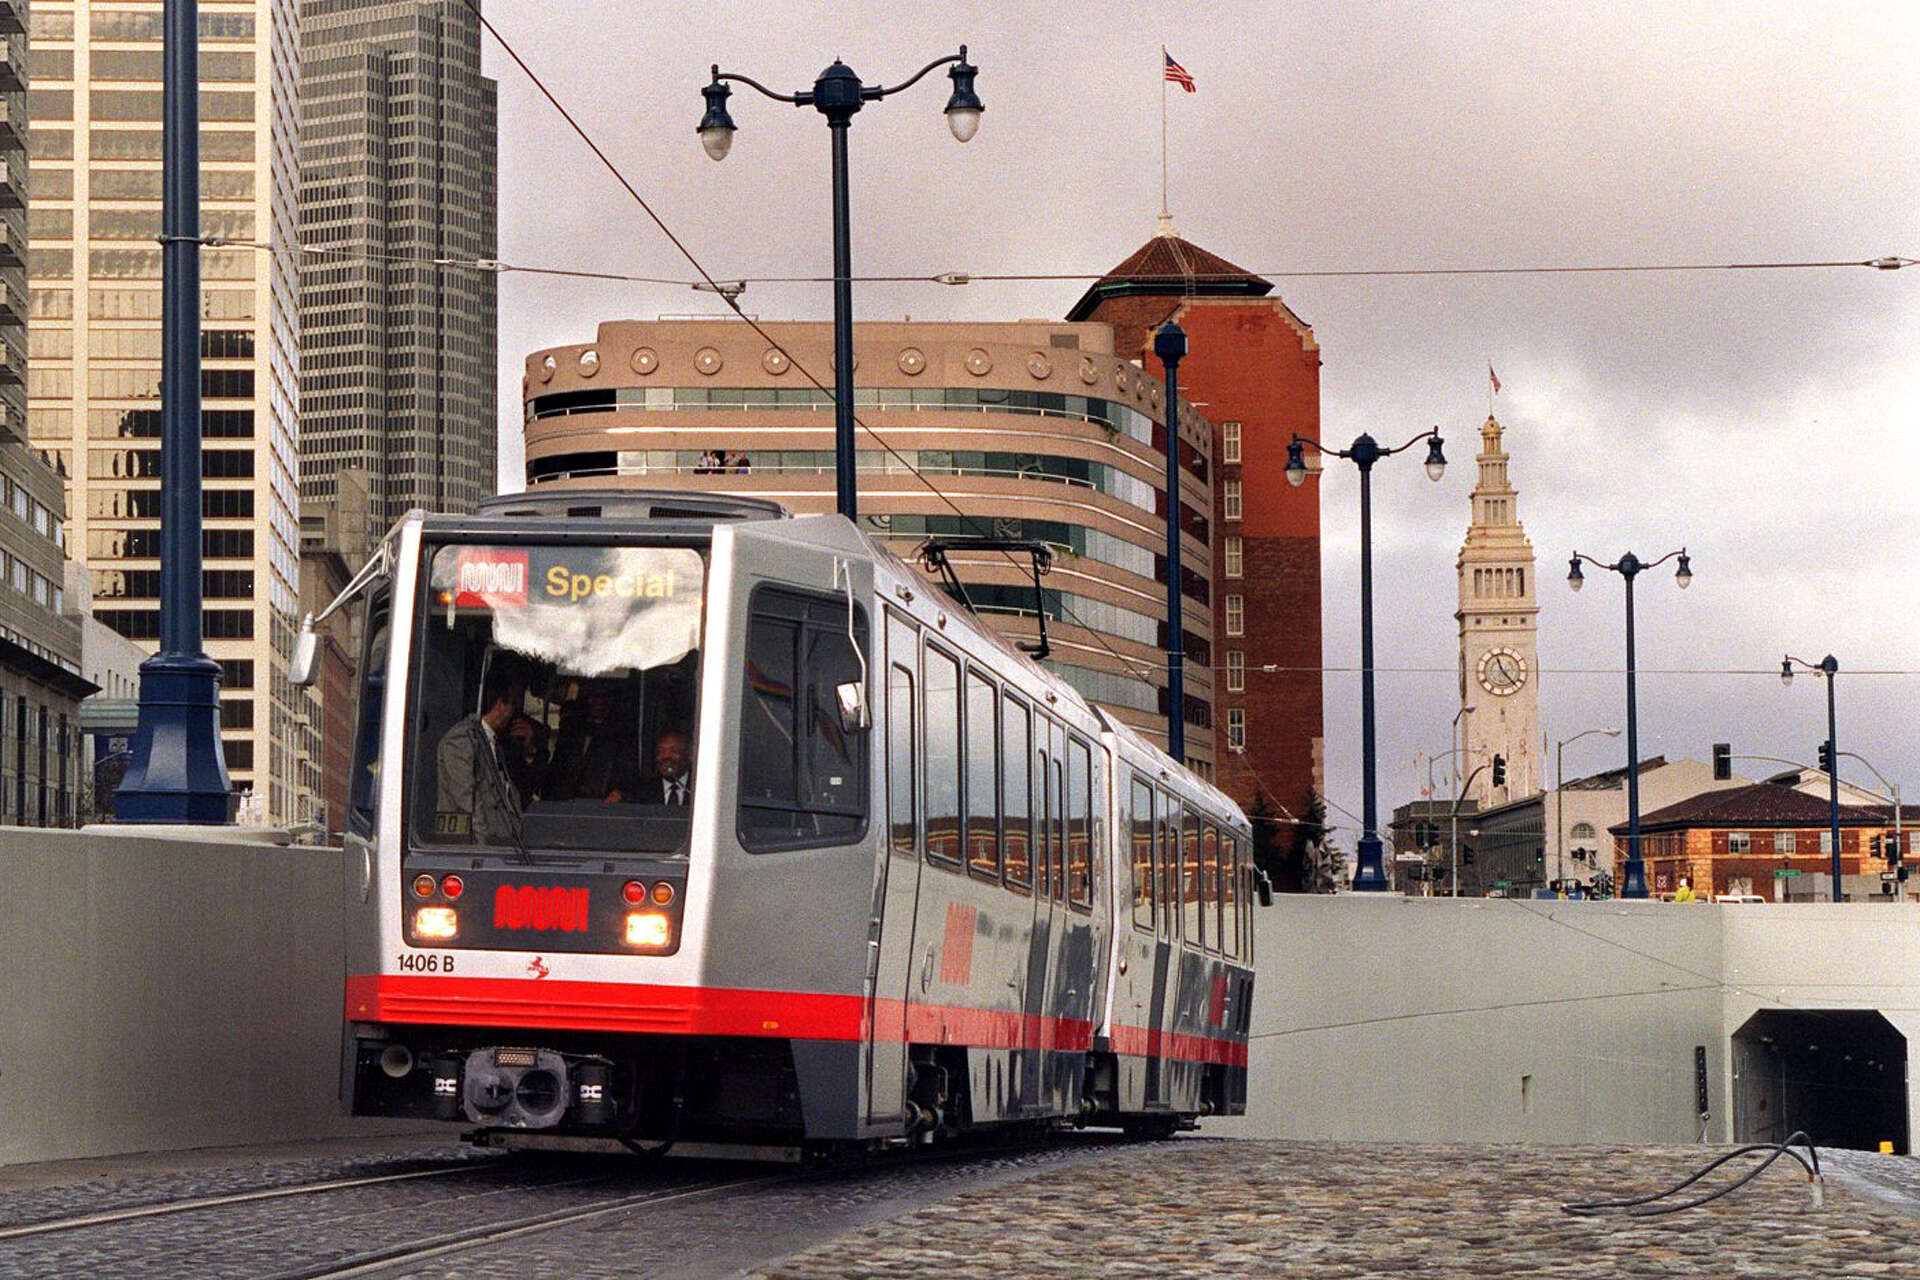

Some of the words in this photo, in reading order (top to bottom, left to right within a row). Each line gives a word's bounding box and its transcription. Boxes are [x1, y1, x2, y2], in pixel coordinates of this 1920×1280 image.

[546, 565, 675, 602] Special
[397, 954, 438, 972] 1406
[443, 955, 455, 972] B
